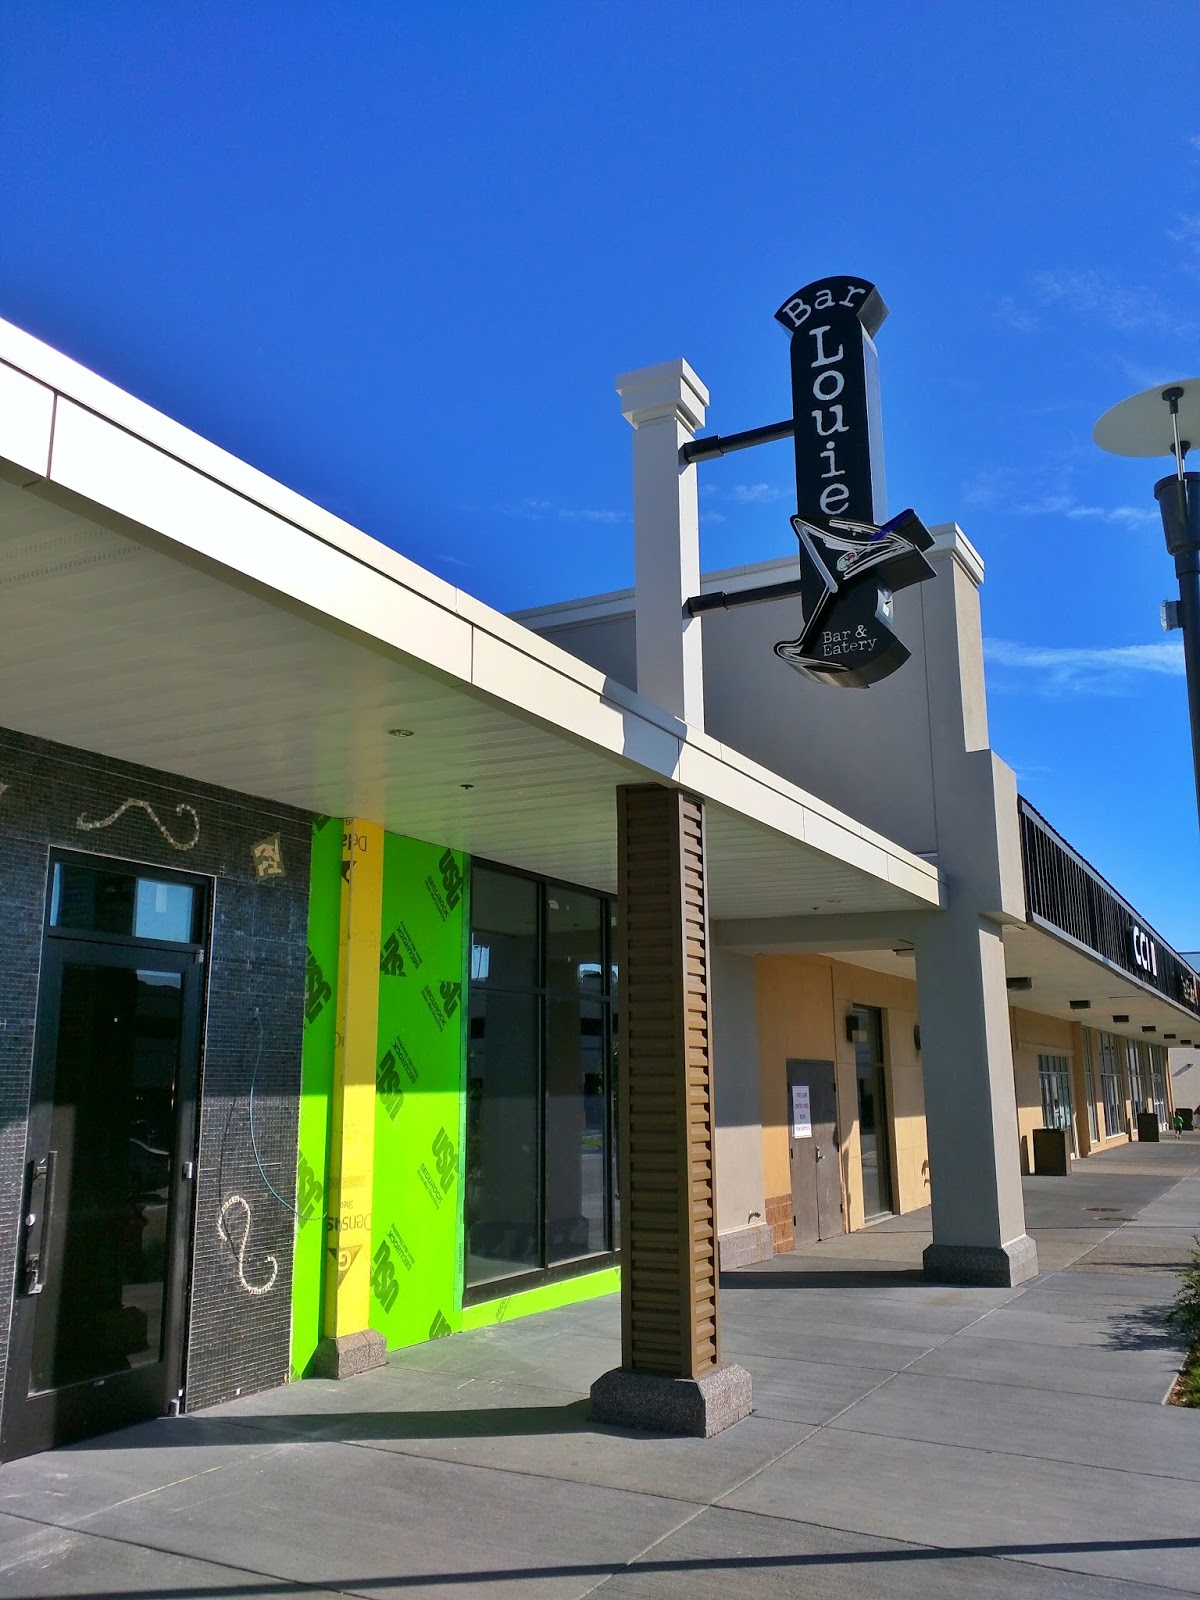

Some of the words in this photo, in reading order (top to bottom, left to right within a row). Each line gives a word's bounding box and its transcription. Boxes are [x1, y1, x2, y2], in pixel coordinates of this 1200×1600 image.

[782, 285, 866, 327] Bar
[808, 325, 850, 515] Louie
[822, 631, 851, 644] Bar
[855, 624, 867, 638] &
[823, 638, 878, 657] Eatery
